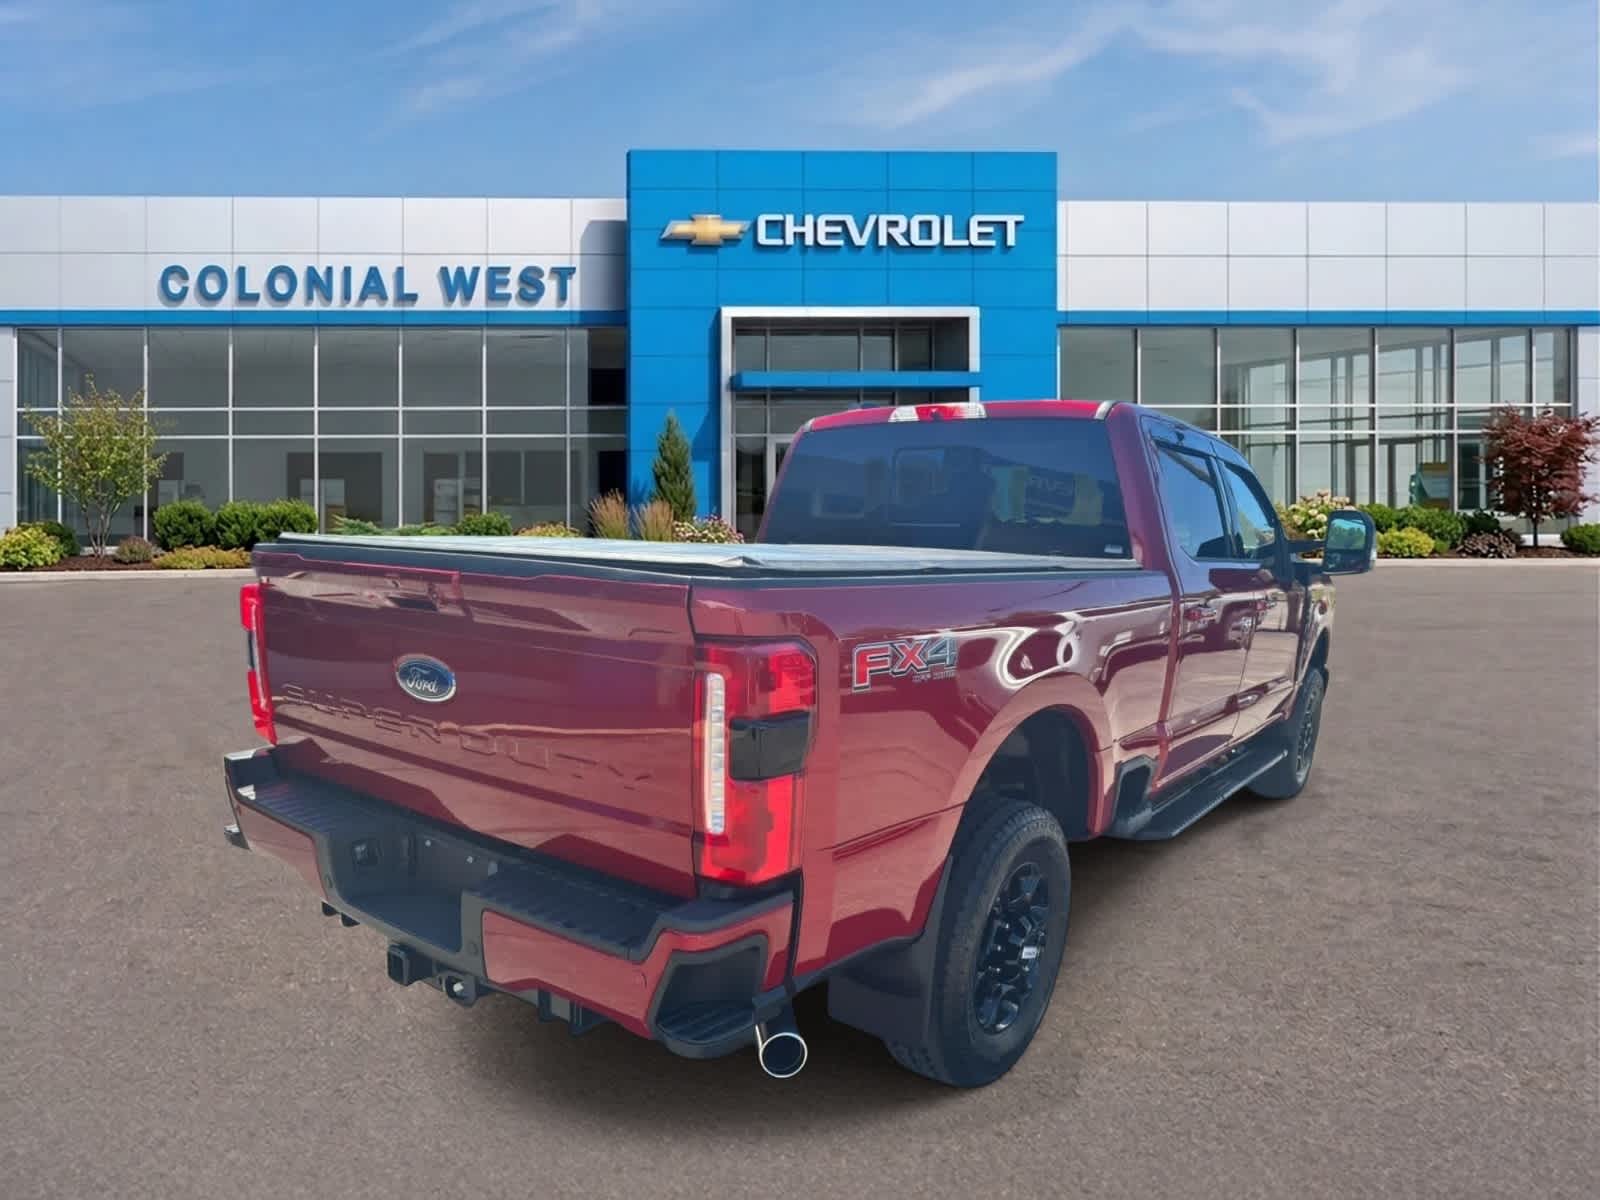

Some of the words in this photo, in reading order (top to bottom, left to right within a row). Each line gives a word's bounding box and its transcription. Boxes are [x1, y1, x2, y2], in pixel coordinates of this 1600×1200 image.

[756, 213, 1024, 248] CHEVROLET
[159, 265, 417, 304] COLONIAL
[438, 265, 577, 304] WEST
[405, 665, 441, 694] Ford
[852, 637, 957, 692] FX4
